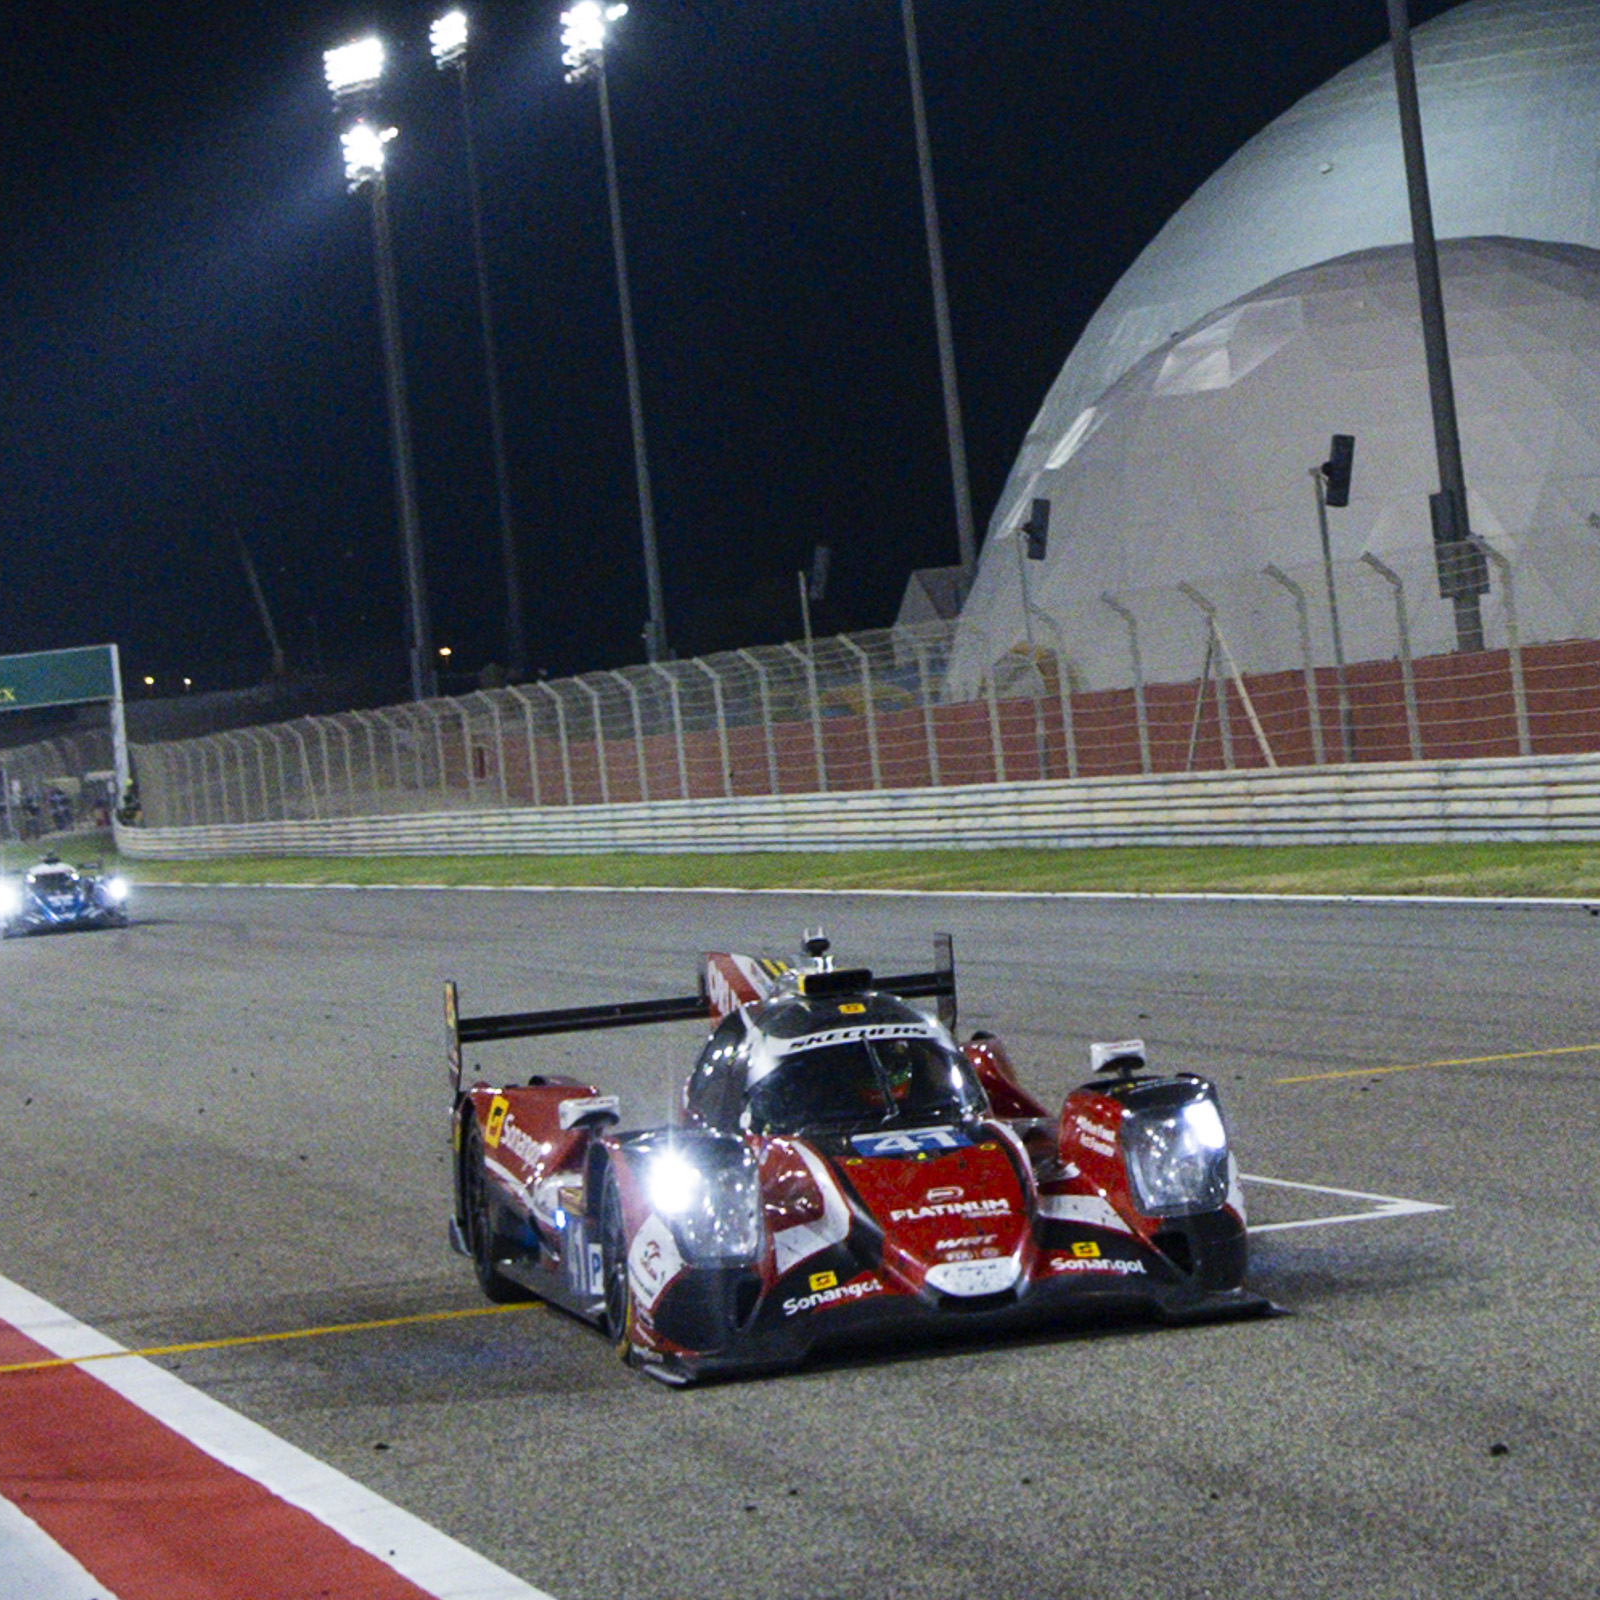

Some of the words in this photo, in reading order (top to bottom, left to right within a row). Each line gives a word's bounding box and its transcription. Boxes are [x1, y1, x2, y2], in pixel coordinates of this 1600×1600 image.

[788, 1025, 929, 1050] SKECHERS
[873, 1131, 959, 1152] 41
[889, 1198, 1010, 1222] PLATINUM
[1050, 1257, 1147, 1275] Sonangol
[782, 1277, 884, 1317] Sonangol
